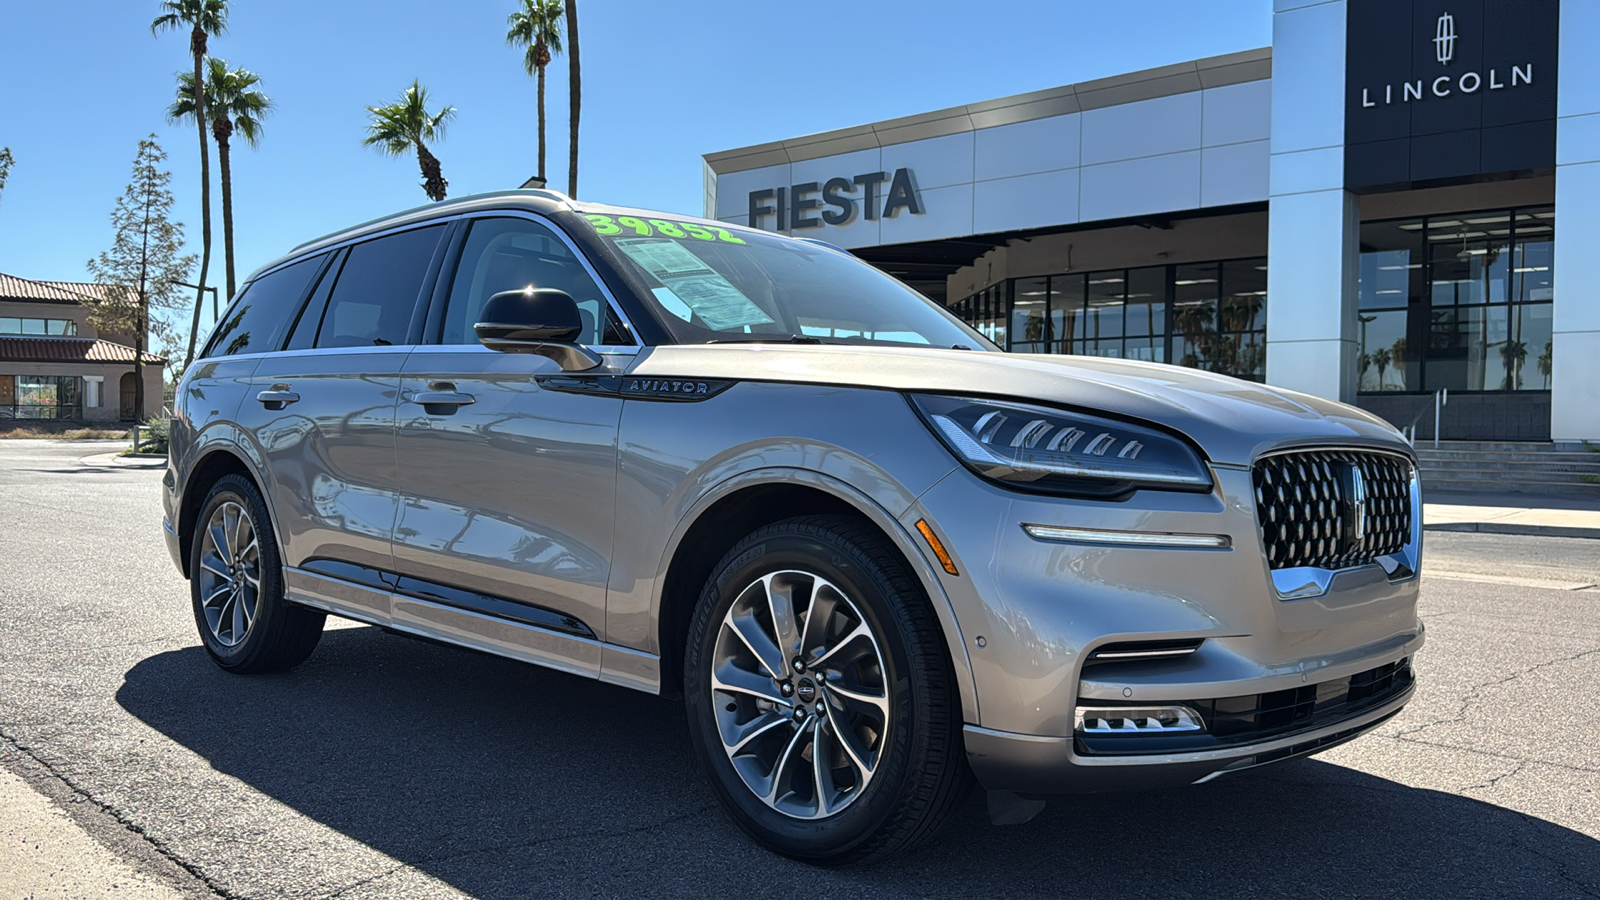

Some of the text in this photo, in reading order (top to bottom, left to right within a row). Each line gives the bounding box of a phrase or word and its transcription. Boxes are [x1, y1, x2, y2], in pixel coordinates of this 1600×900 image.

[1362, 63, 1532, 107] LINCOLN
[748, 167, 926, 231] FIESTA
[584, 214, 747, 245] 39852
[629, 380, 709, 394] AVIATOR
[691, 587, 719, 666] MICHELIN
